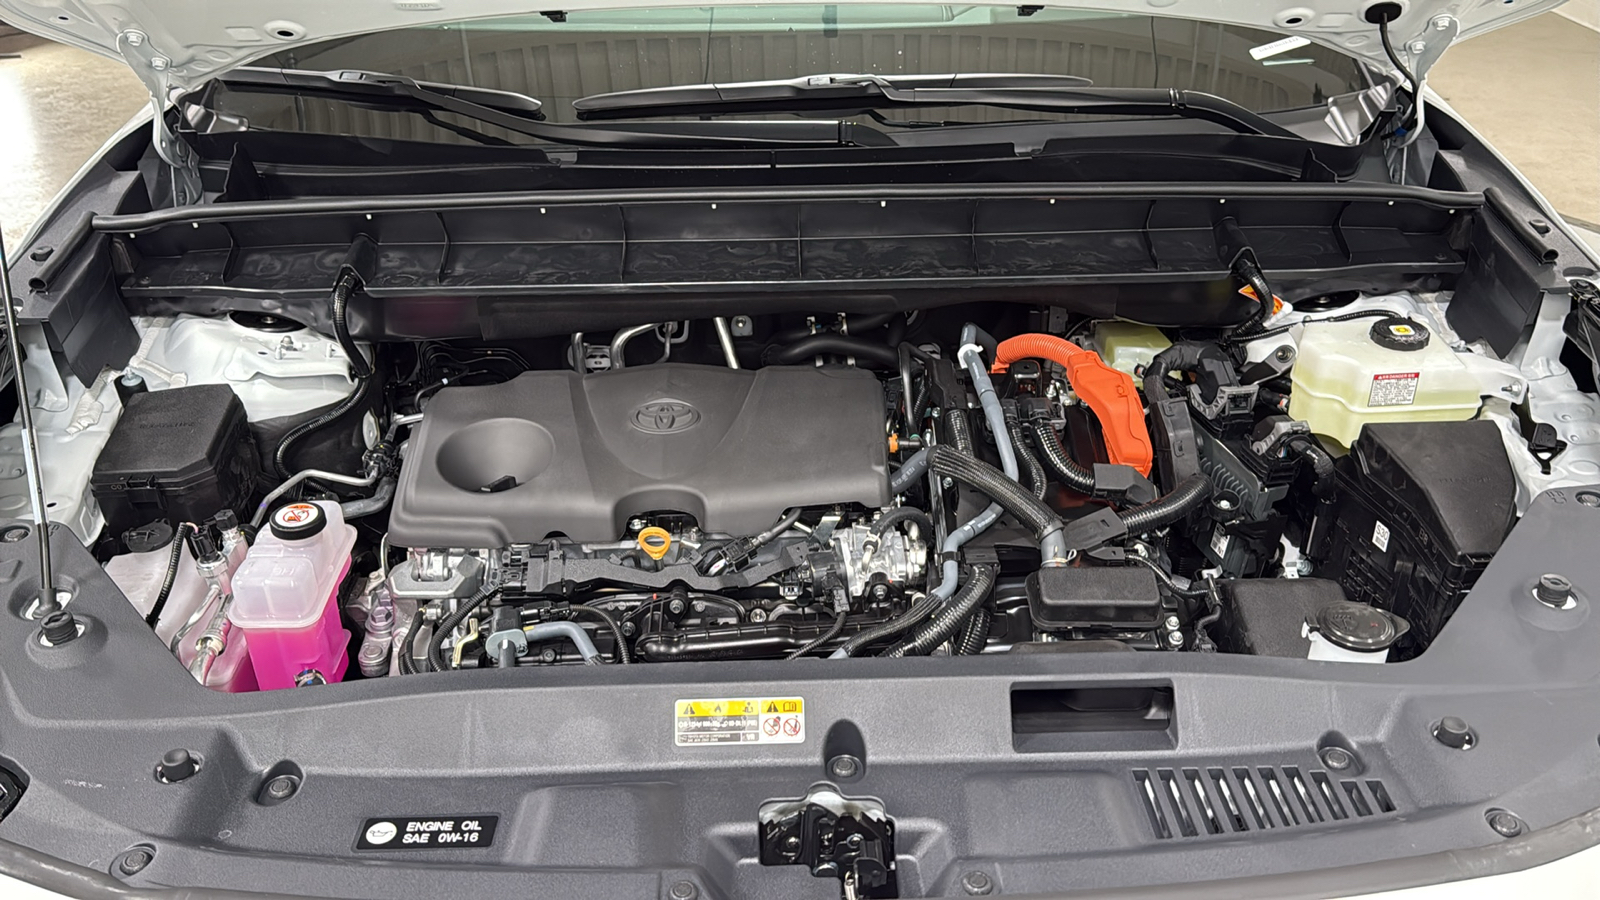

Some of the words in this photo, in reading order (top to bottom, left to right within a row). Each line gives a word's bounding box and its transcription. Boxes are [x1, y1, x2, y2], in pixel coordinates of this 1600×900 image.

[1375, 524, 1389, 541] S30
[405, 821, 454, 832] ENGINE
[461, 820, 482, 831] OIL
[402, 833, 430, 844] SAE
[437, 832, 479, 843] 0W-16
